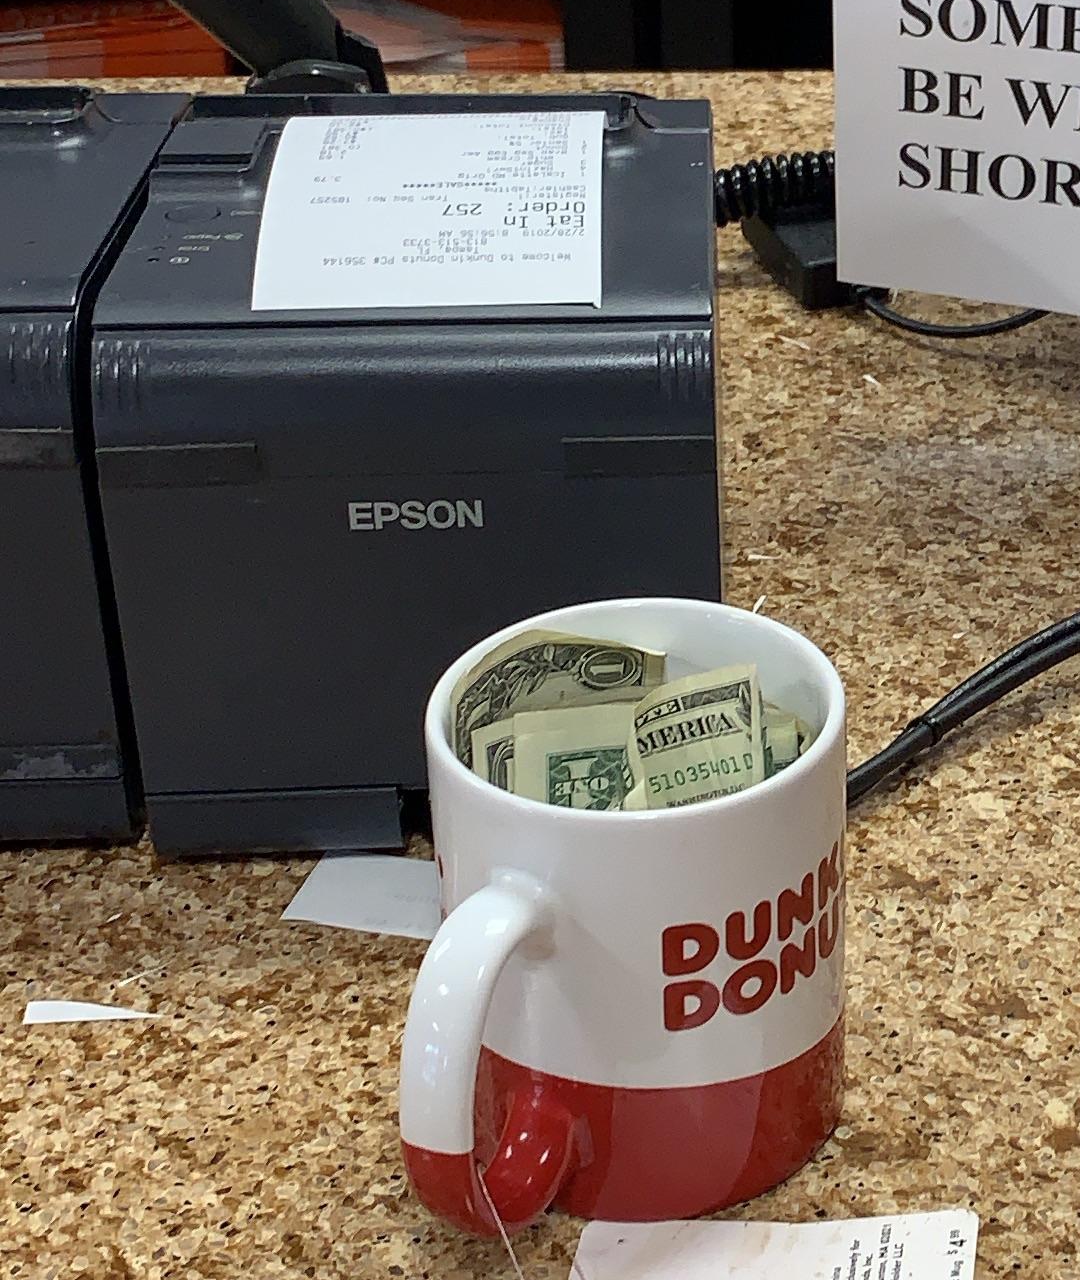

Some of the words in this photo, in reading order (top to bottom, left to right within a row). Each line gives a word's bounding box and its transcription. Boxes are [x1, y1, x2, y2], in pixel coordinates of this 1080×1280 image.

[898, 66, 985, 121] BE
[441, 203, 482, 216] 257
[507, 201, 585, 215] Order:
[503, 215, 529, 229] In
[546, 215, 584, 227] Eat
[438, 230, 453, 239] AM
[417, 246, 431, 255] FL
[439, 244, 479, 254] Tampa,
[322, 257, 366, 266] 356144
[402, 255, 444, 264] Donuts
[450, 254, 494, 263] Dunkin
[500, 254, 514, 262] to
[521, 253, 571, 261] Welcome
[348, 499, 484, 530] EPSON
[662, 841, 839, 976] DUNK
[664, 896, 839, 1032] DONU
[850, 1239, 860, 1251] for
[894, 1243, 904, 1258] LLC
[879, 1246, 888, 1259] MA
[949, 1260, 963, 1277] Mug
